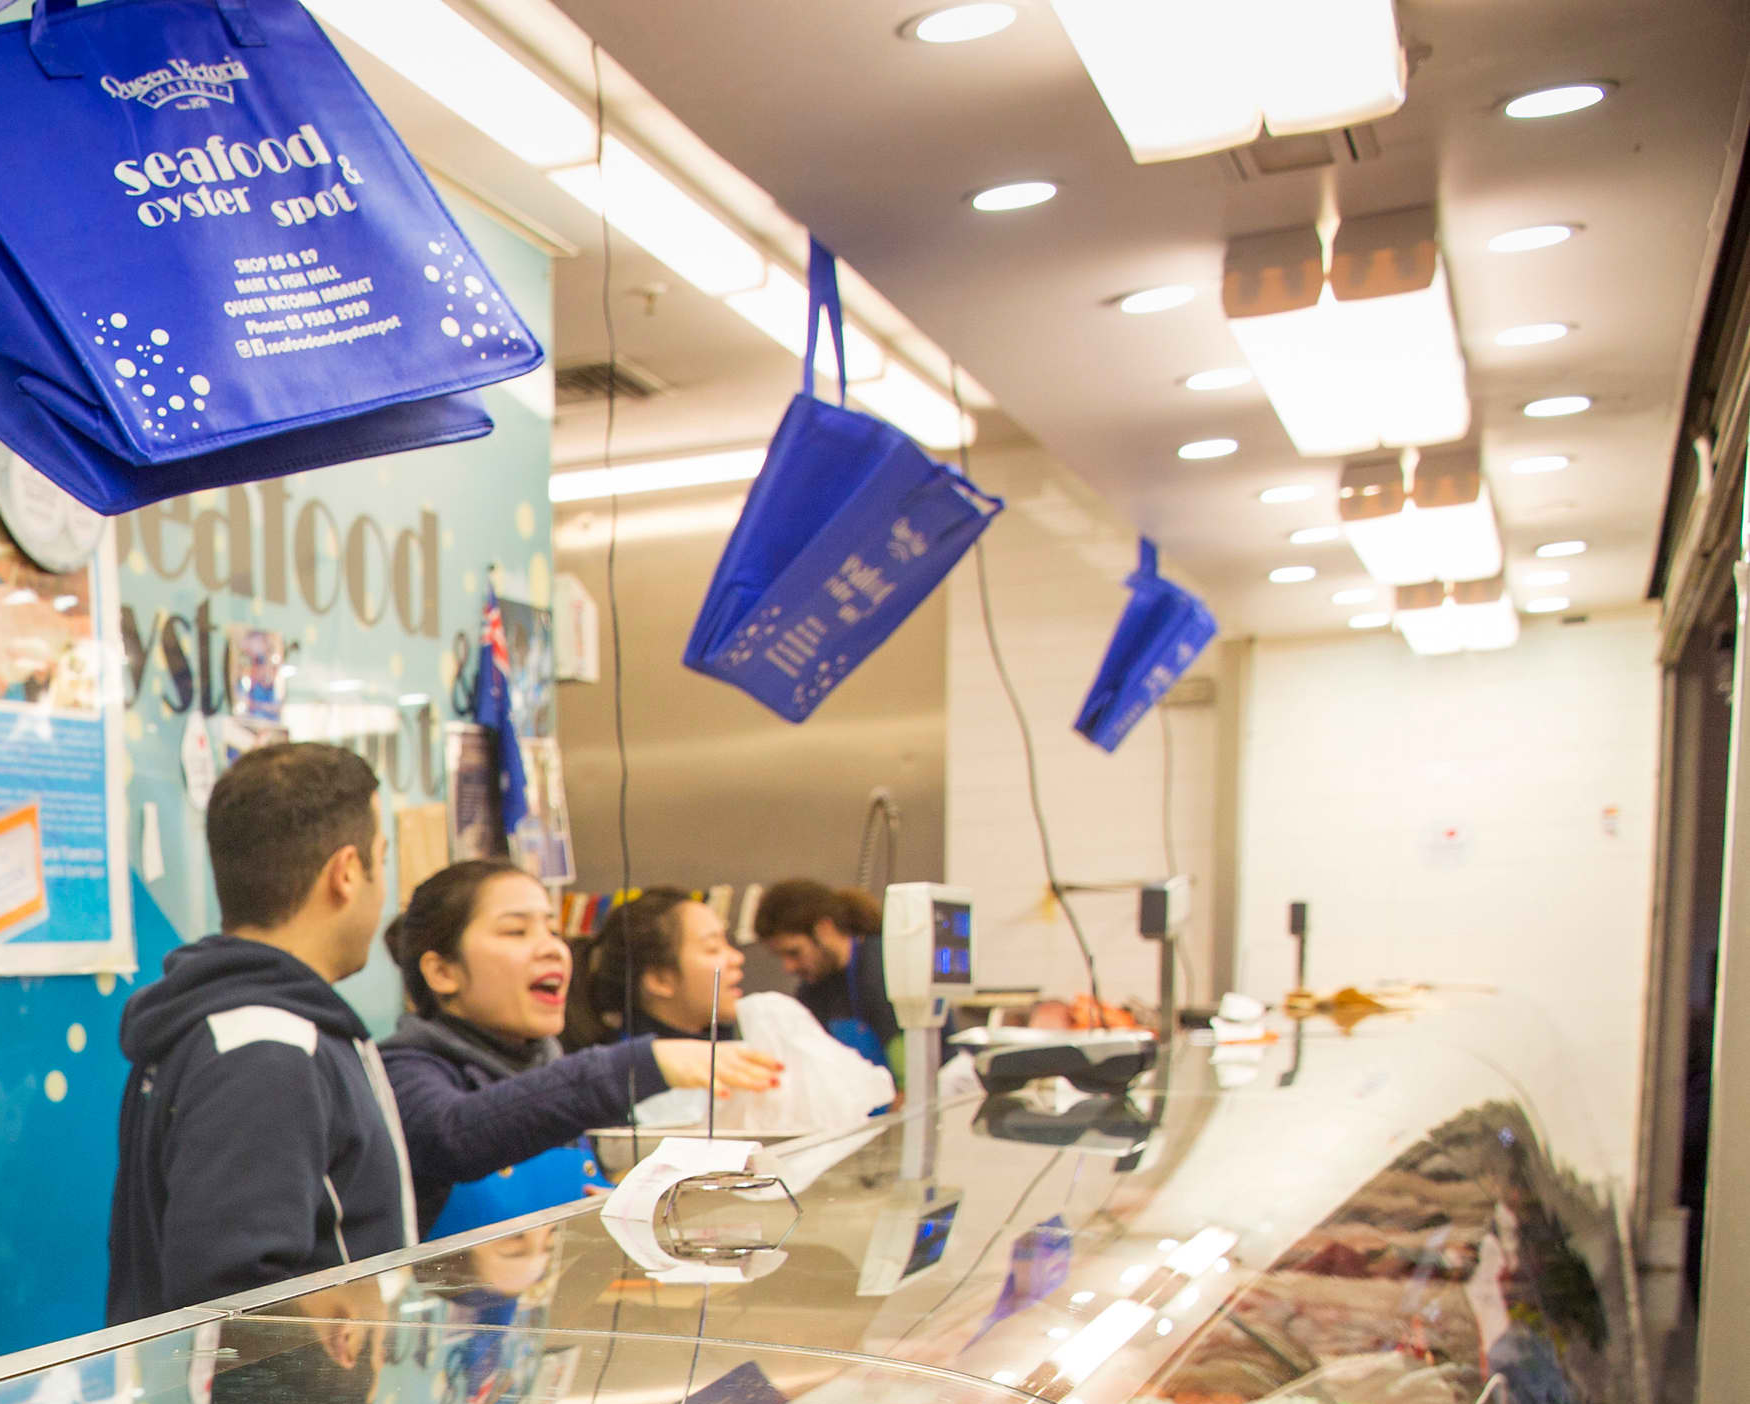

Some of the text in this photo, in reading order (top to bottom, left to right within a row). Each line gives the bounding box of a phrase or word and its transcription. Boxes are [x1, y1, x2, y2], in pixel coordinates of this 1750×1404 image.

[100, 54, 249, 99] Queen Victoria
[153, 80, 218, 98] MARKET
[113, 123, 365, 196] seafood &
[137, 182, 357, 227] oyster spot
[234, 256, 268, 274] SHOP
[300, 248, 318, 265] 29
[306, 265, 342, 285] HALL
[223, 276, 374, 317] QUEEN VICTORIA MARKET
[335, 300, 370, 321] 2929
